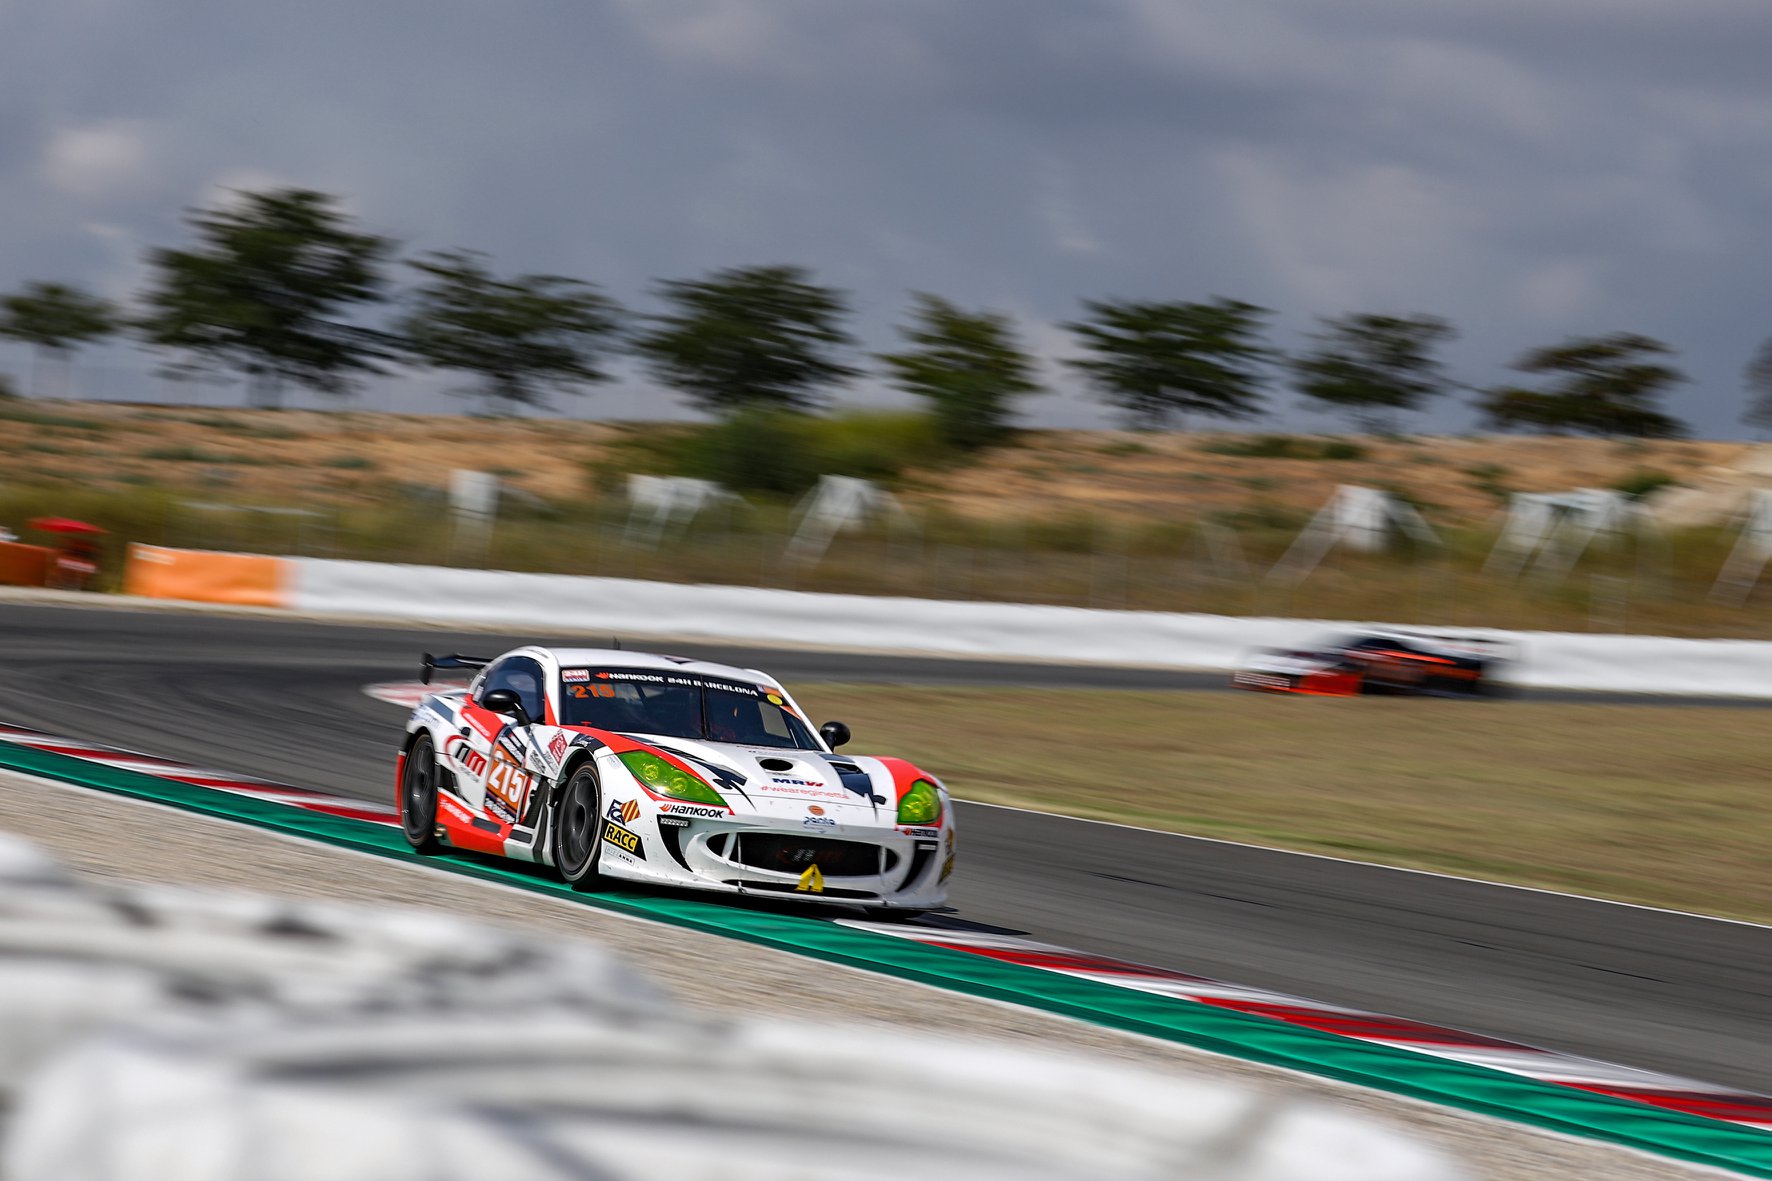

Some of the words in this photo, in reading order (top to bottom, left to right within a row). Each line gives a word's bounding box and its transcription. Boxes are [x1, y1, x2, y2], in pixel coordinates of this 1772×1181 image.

[668, 677, 691, 686] 24H
[571, 684, 615, 698] 215
[488, 750, 524, 803] 215
[772, 778, 824, 787] MRW
[606, 825, 637, 850] RACC
